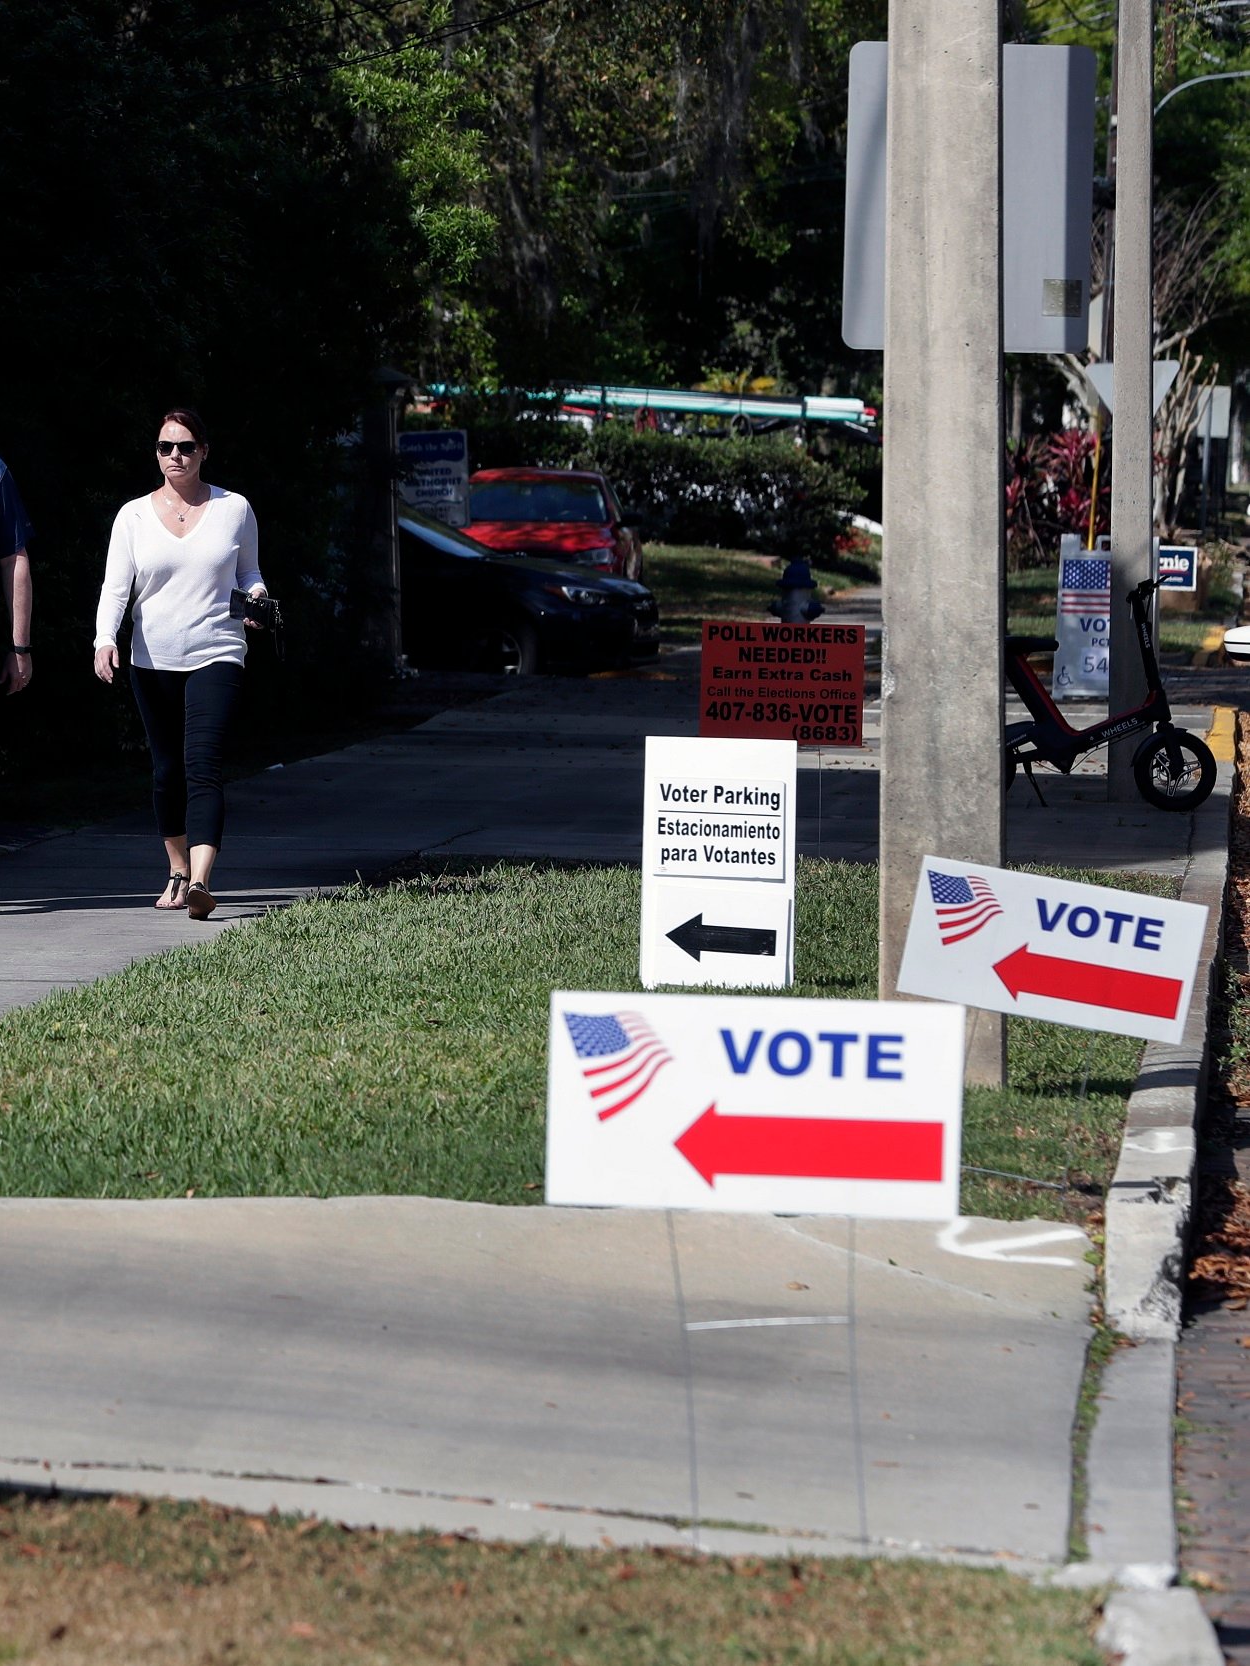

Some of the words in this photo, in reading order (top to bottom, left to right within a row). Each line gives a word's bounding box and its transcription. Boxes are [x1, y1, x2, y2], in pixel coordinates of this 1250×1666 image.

[415, 488, 454, 497] CHURCH
[1080, 617, 1110, 632] VO
[708, 625, 757, 641] POLL
[762, 627, 858, 644] WORKERS
[738, 646, 827, 664] NEEDED!!
[712, 666, 752, 680] Earn
[758, 668, 803, 681] Extra
[810, 669, 852, 682] Cash
[707, 686, 731, 697] Call
[735, 687, 754, 698] the
[758, 687, 816, 699] Elections
[820, 689, 856, 700] Office
[706, 701, 857, 724] 407-836-VOTE
[792, 724, 858, 742] (8683)
[1101, 717, 1138, 738] WHEELS
[660, 783, 708, 803] Voter
[714, 785, 780, 811] Parking
[658, 817, 780, 840] Estacionamiento
[661, 847, 698, 865] para
[703, 845, 776, 865] Votantes
[1036, 898, 1165, 951] VOTE
[719, 1029, 904, 1080] VOTE
